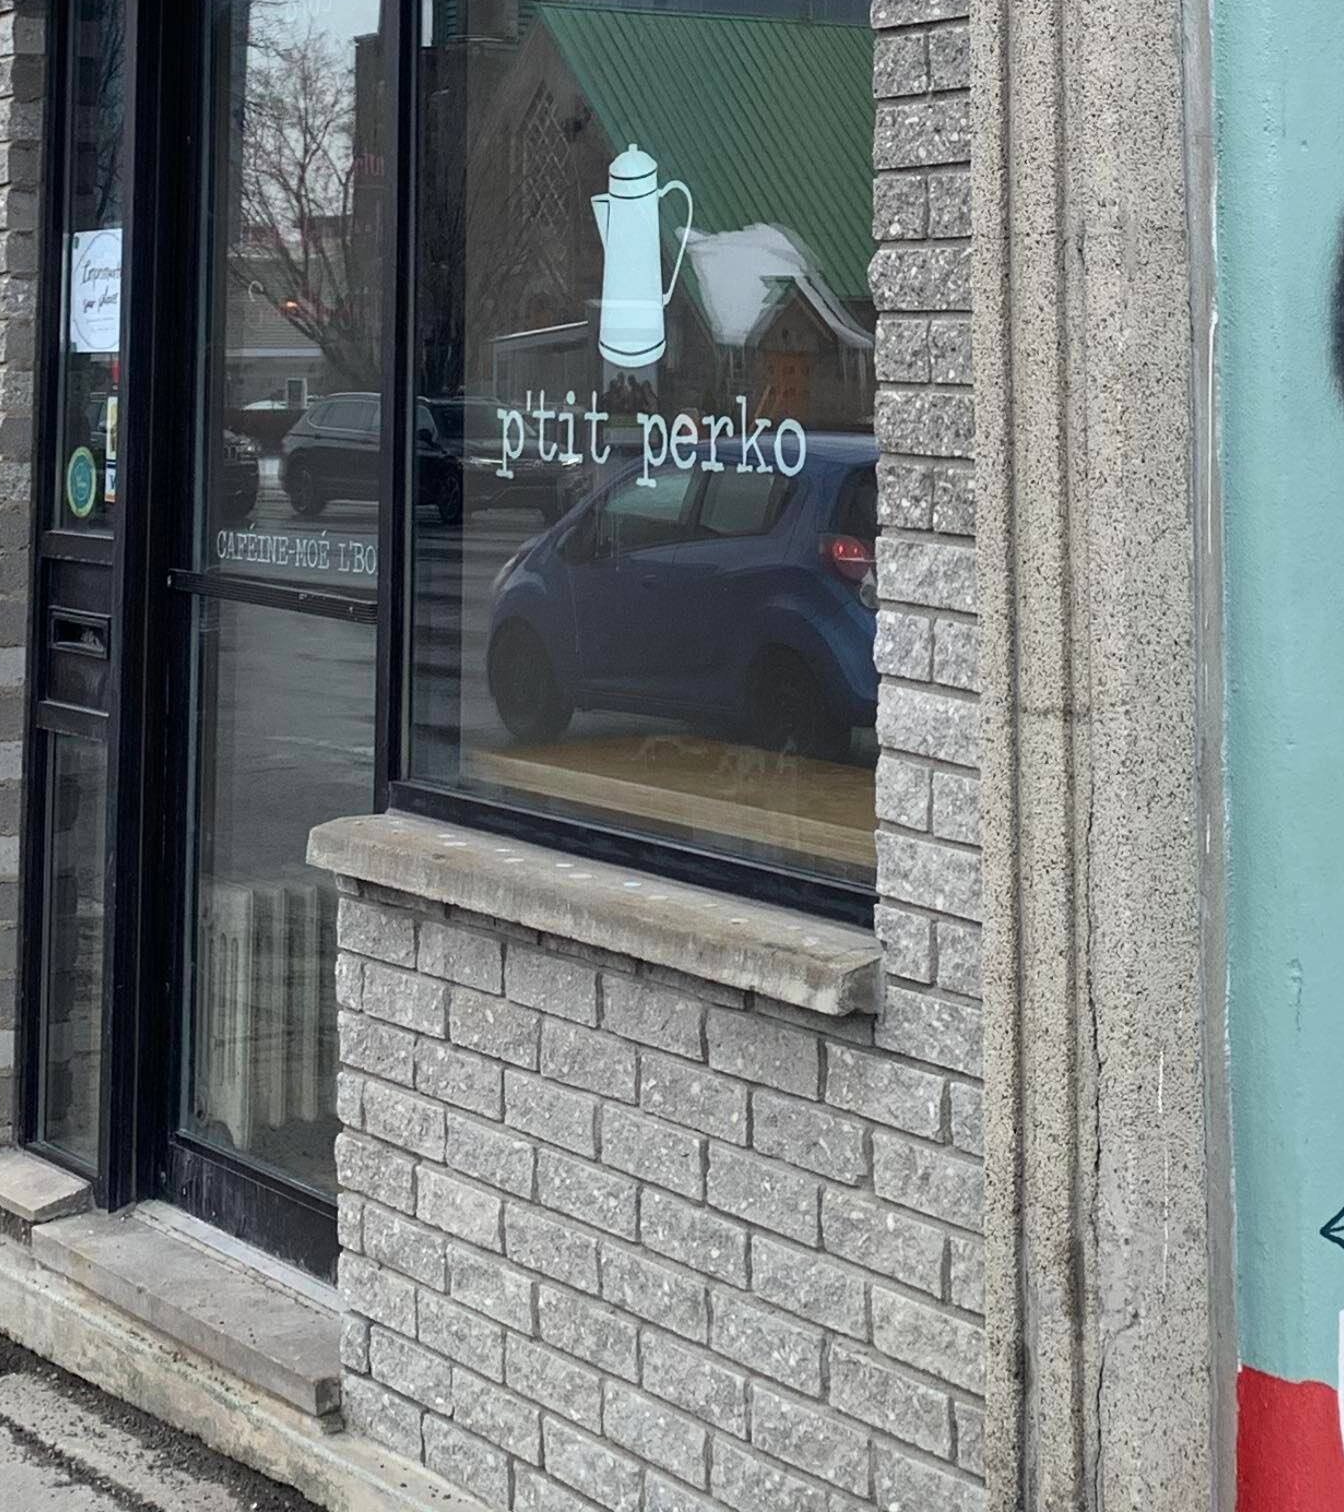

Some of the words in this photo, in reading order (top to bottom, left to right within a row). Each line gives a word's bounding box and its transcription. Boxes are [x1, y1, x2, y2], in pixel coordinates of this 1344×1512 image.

[496, 389, 610, 479] p'tit
[636, 395, 806, 488] perko
[338, 540, 378, 575] L'BO
